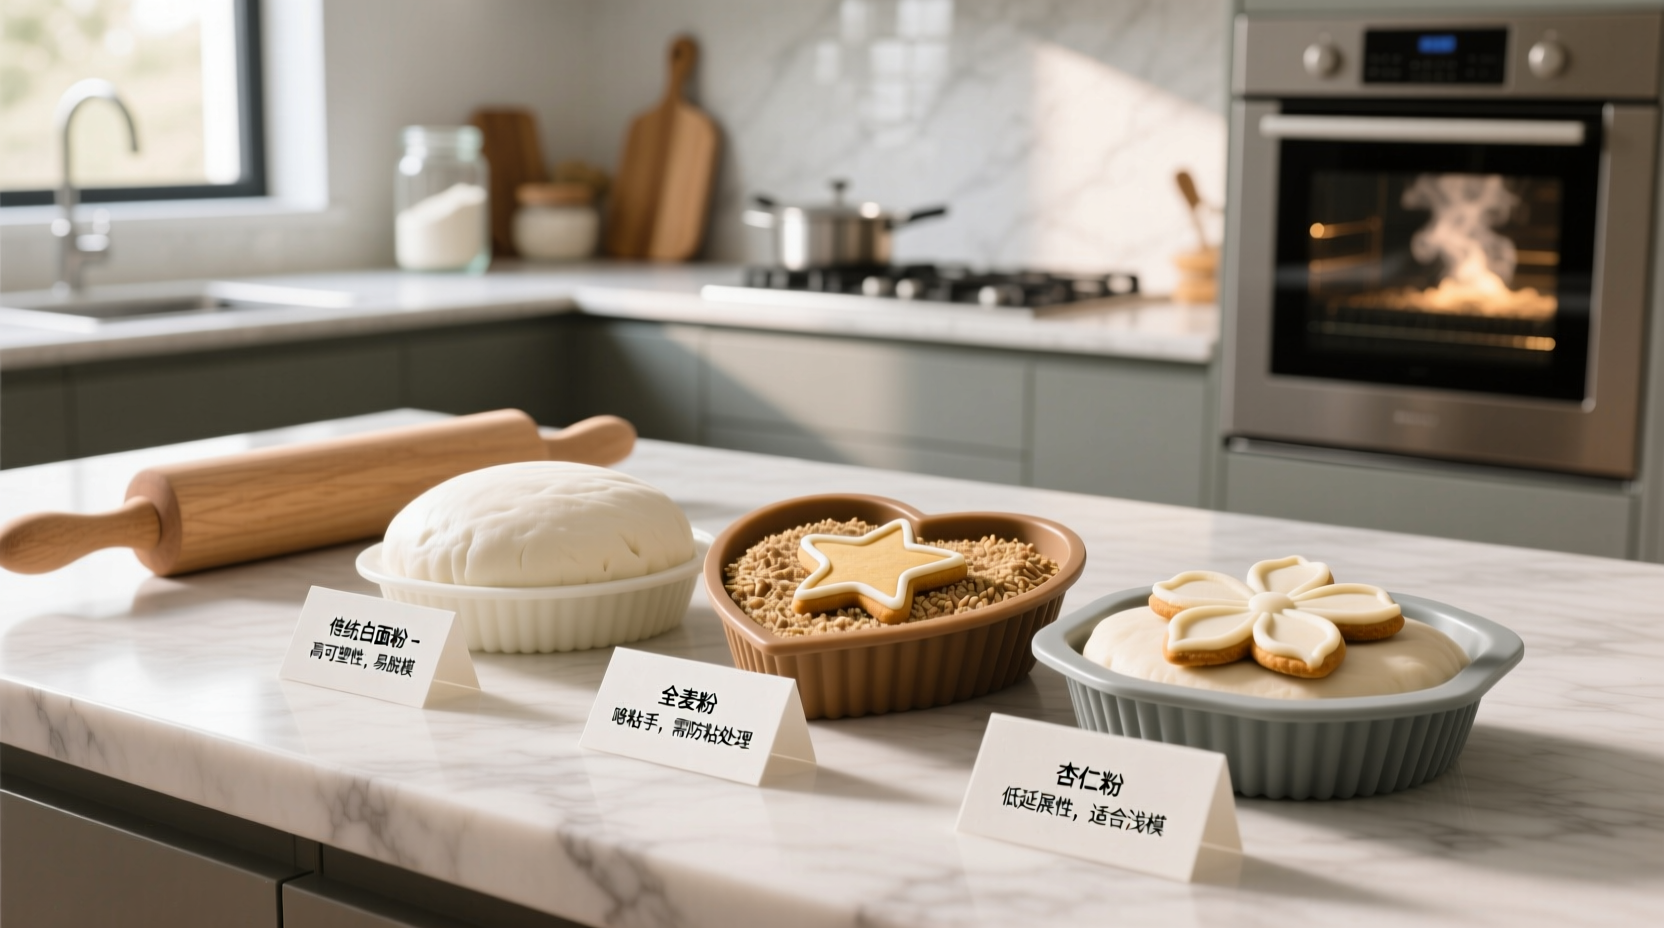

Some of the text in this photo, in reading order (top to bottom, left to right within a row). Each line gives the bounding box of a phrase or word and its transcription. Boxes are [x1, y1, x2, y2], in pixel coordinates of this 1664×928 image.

[657, 684, 718, 714] 全麦粉
[1056, 761, 1125, 797] 杏仁粉
